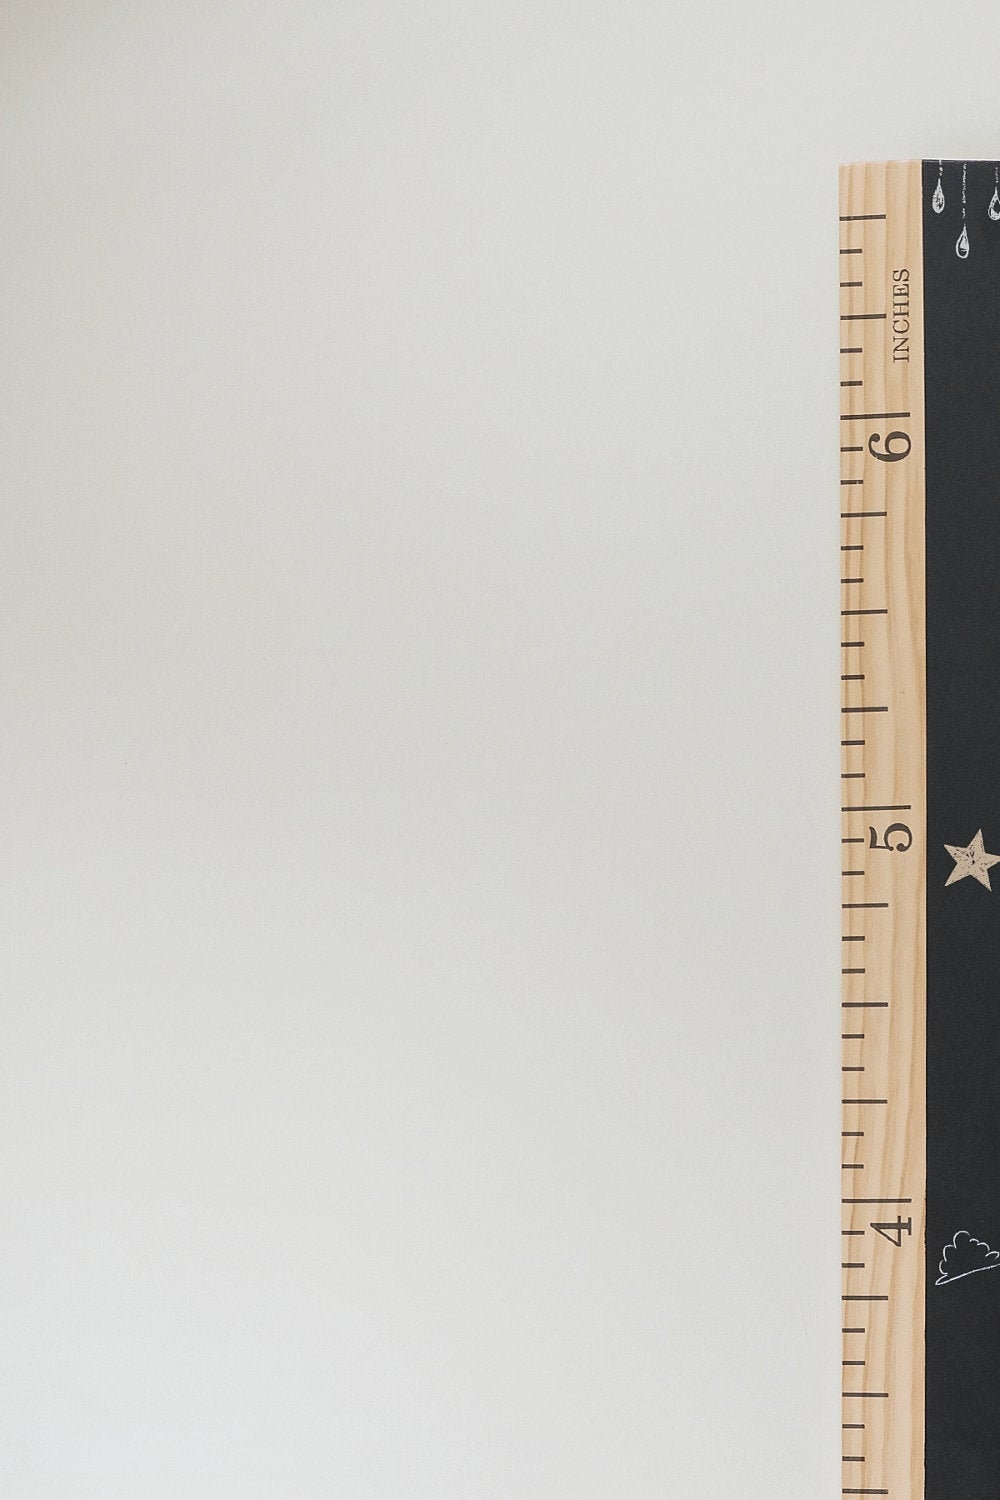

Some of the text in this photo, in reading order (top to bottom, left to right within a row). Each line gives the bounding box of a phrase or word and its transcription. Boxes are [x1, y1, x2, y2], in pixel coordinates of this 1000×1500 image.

[892, 268, 910, 363] INCHES
[868, 430, 912, 463] 6
[869, 822, 913, 852] 5
[870, 1215, 912, 1247] 4
